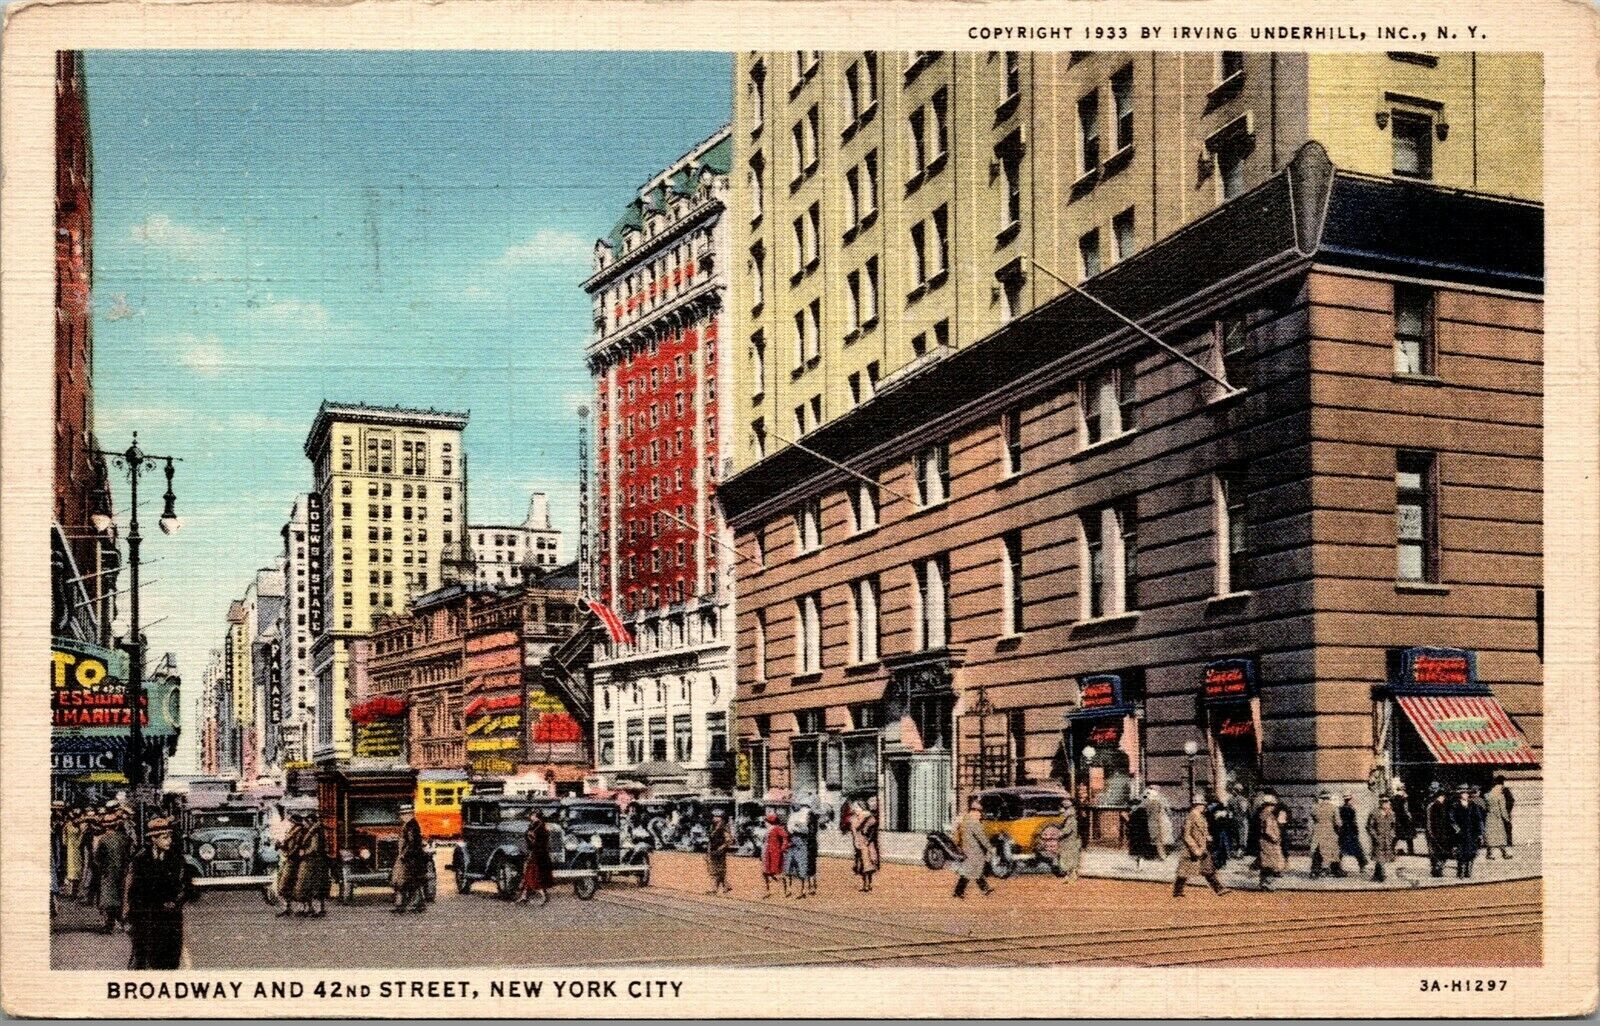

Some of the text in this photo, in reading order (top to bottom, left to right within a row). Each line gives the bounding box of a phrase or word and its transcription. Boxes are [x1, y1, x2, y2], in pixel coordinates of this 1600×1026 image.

[310, 573, 322, 632] STATE
[51, 651, 107, 688] TO
[271, 644, 281, 721] PALACE
